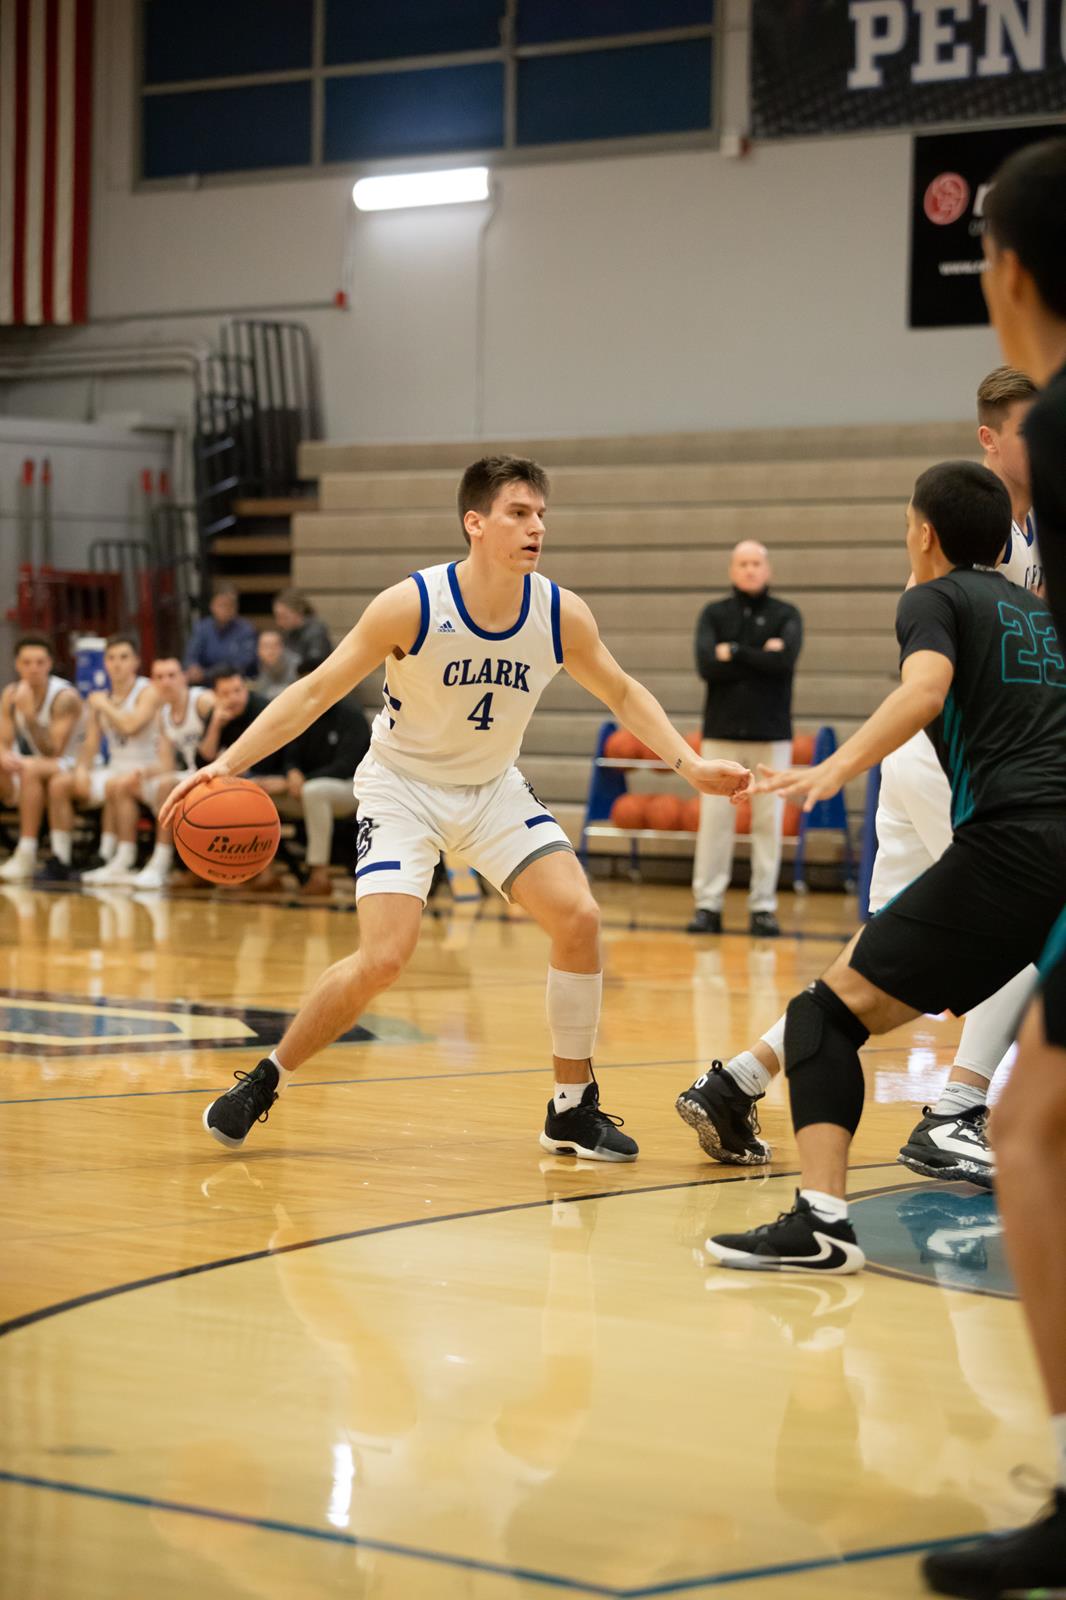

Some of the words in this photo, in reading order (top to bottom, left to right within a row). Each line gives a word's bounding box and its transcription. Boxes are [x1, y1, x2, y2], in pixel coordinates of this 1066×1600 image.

[847, 0, 1066, 90] PEN
[442, 658, 531, 693] CLARK
[467, 692, 494, 731] 4
[207, 835, 273, 855] Baden
